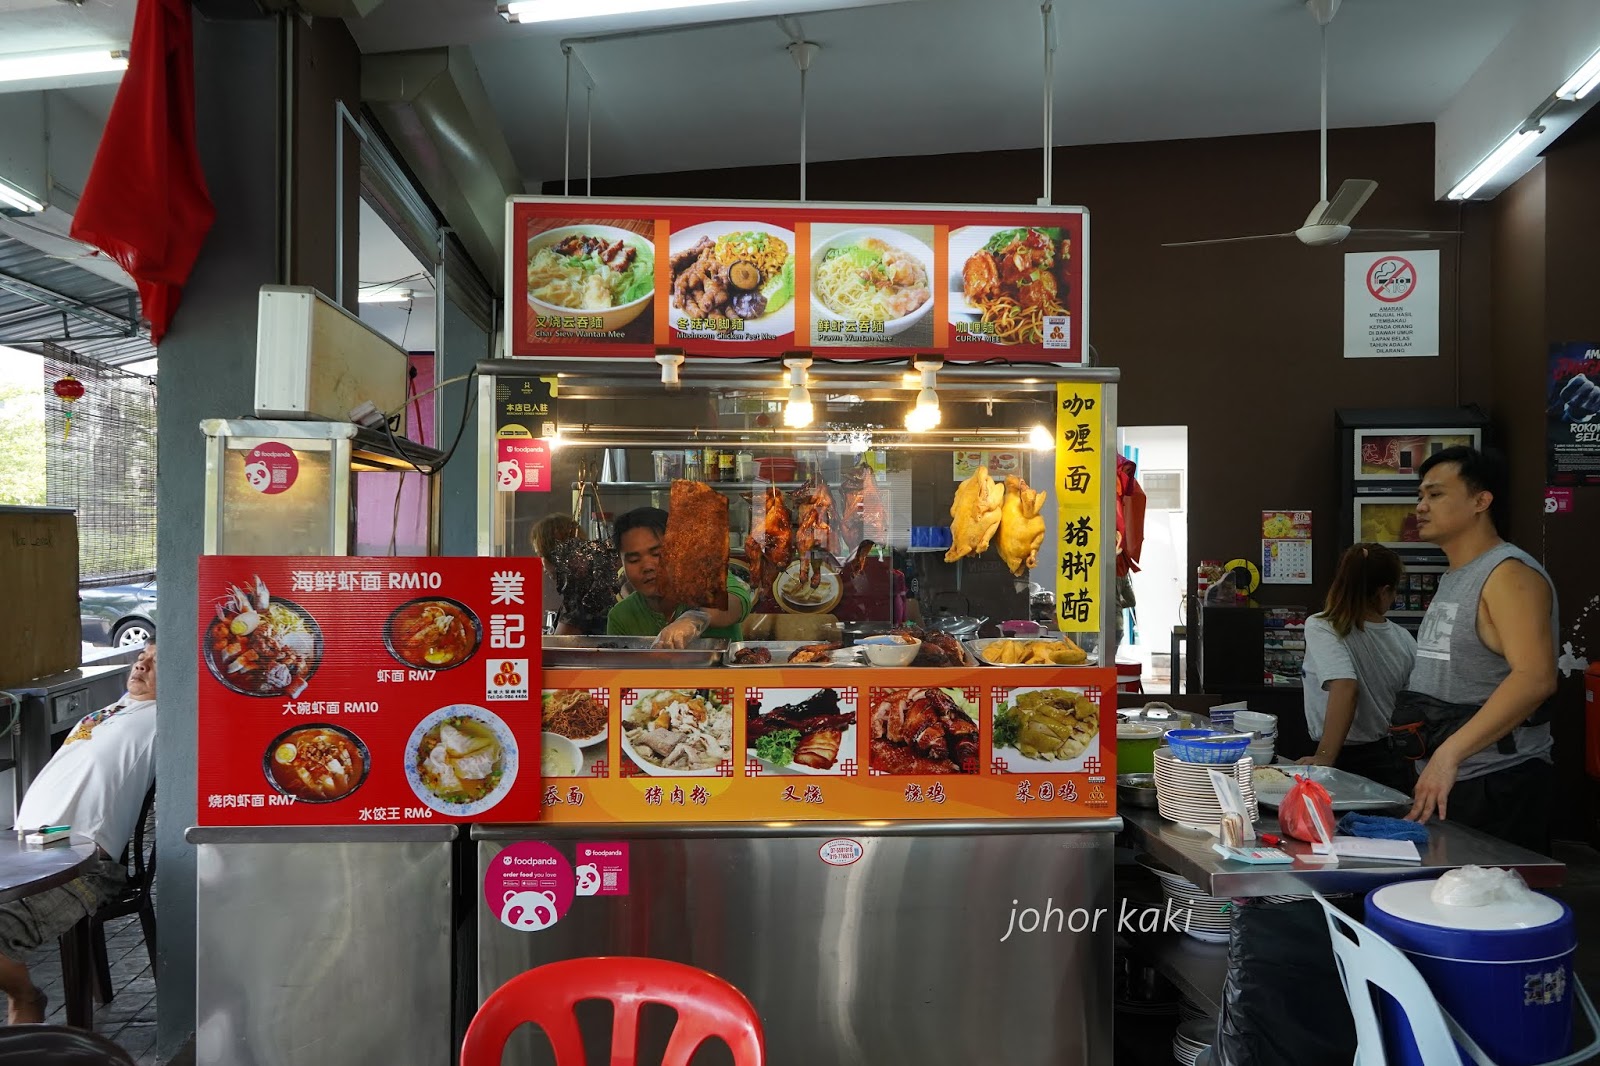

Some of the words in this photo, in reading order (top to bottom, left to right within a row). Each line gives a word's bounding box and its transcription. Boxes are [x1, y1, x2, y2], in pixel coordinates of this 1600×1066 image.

[555, 329, 574, 337] Siew
[576, 330, 606, 338] Wantan
[608, 330, 626, 338] Mee
[676, 331, 715, 339] Mushroom
[716, 332, 743, 340] Chicken
[745, 333, 760, 341] Feet
[761, 333, 777, 341] Mee
[818, 334, 843, 342] Prawn
[844, 334, 874, 342] Wantan
[876, 334, 894, 342] Mee
[955, 335, 983, 343] CURRY
[985, 336, 1001, 344] MEE
[1584, 349, 1600, 359] AM
[261, 450, 291, 458] foodpanda
[514, 446, 544, 454] foodpanda
[1061, 516, 1096, 623] 猪脚醋
[291, 570, 382, 592] 海鲜虾面
[388, 572, 442, 590] RM10
[489, 571, 526, 649] 業記
[377, 670, 405, 683] 虾面
[408, 670, 437, 682] RM7
[282, 700, 340, 716] 大碗虾面
[343, 701, 379, 714] RM10
[781, 785, 824, 803] 叉烧
[904, 783, 946, 803] 烧鸡
[1015, 780, 1078, 802] 菜园鸡
[208, 794, 265, 808] 烧肉虾面
[268, 794, 297, 807] RM7
[358, 807, 401, 821] 水饺王
[404, 807, 432, 819] RM6
[592, 849, 622, 857] foodpanda
[514, 856, 557, 866] foodpanda
